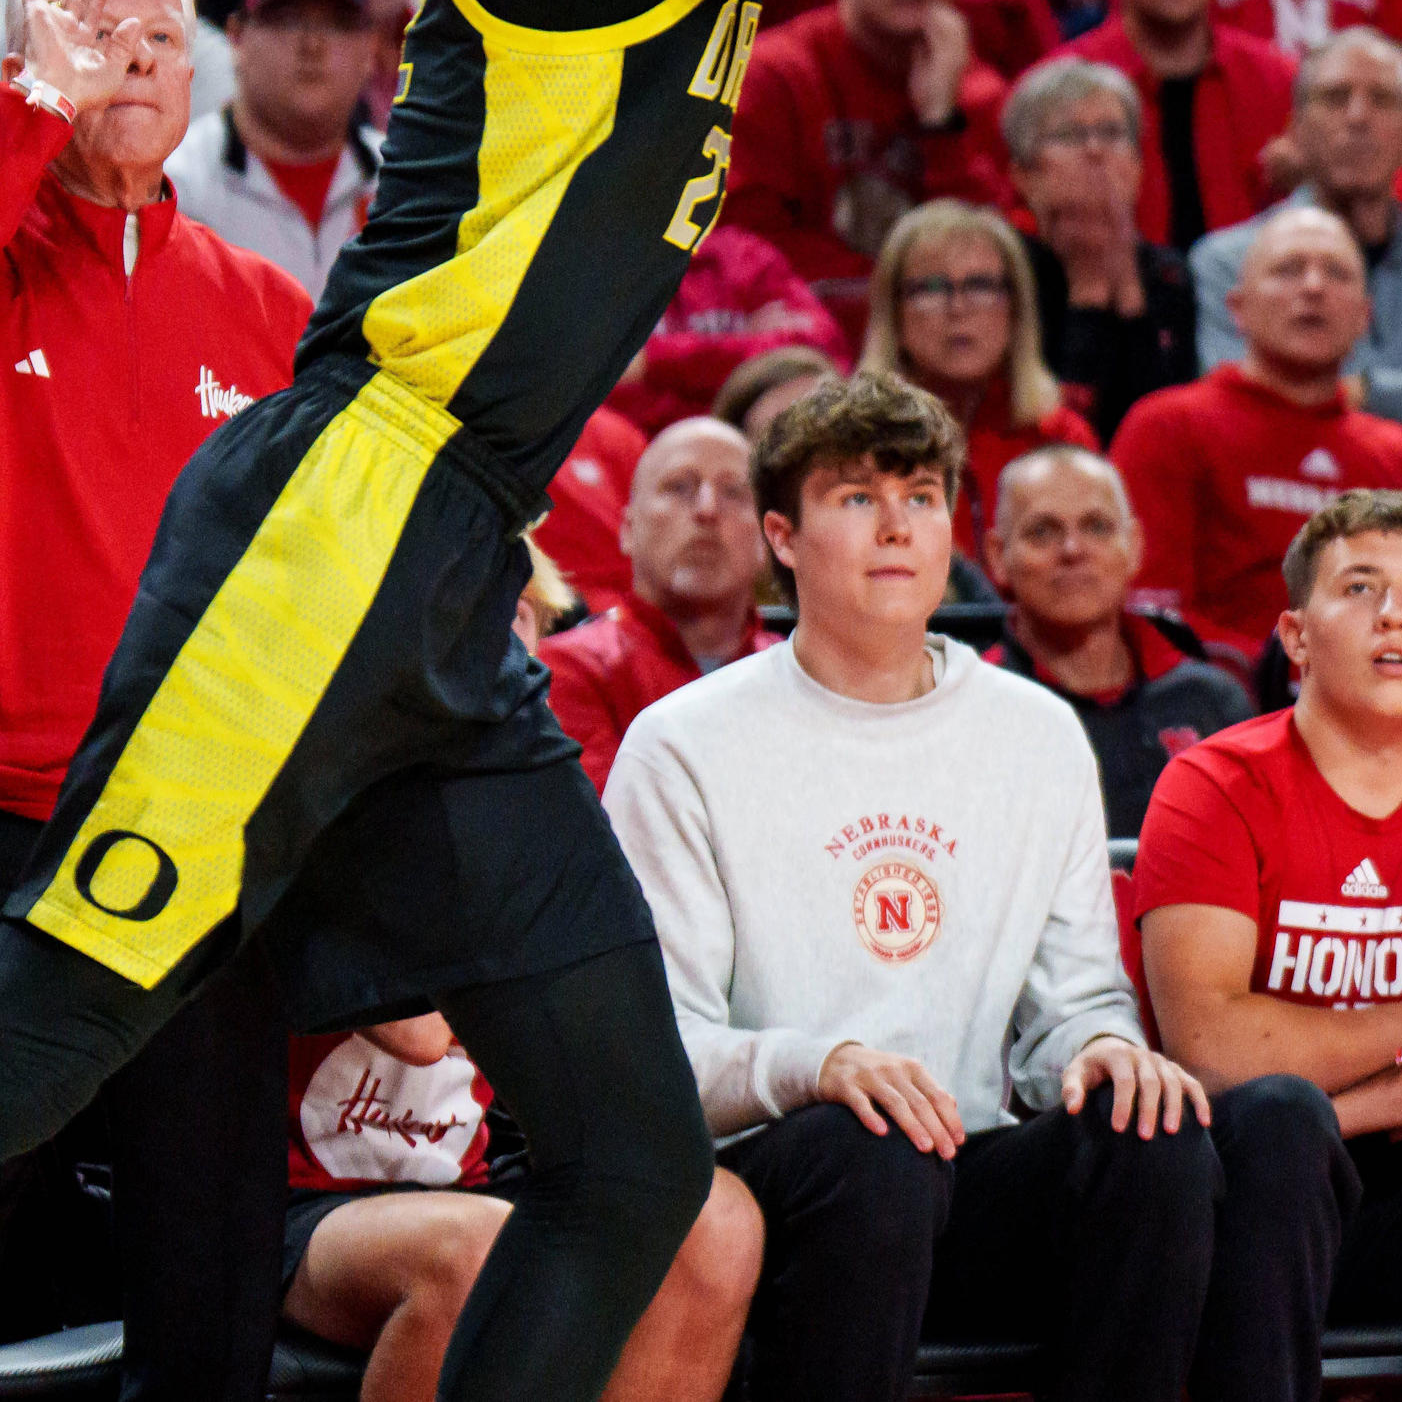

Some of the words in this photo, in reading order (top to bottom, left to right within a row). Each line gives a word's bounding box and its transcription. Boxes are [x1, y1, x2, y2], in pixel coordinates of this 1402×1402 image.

[824, 812, 958, 860] NEBRASKA
[852, 834, 936, 861] CORNHUSKERS
[74, 829, 179, 921] O
[1341, 881, 1389, 899] adidas
[876, 893, 911, 932] N
